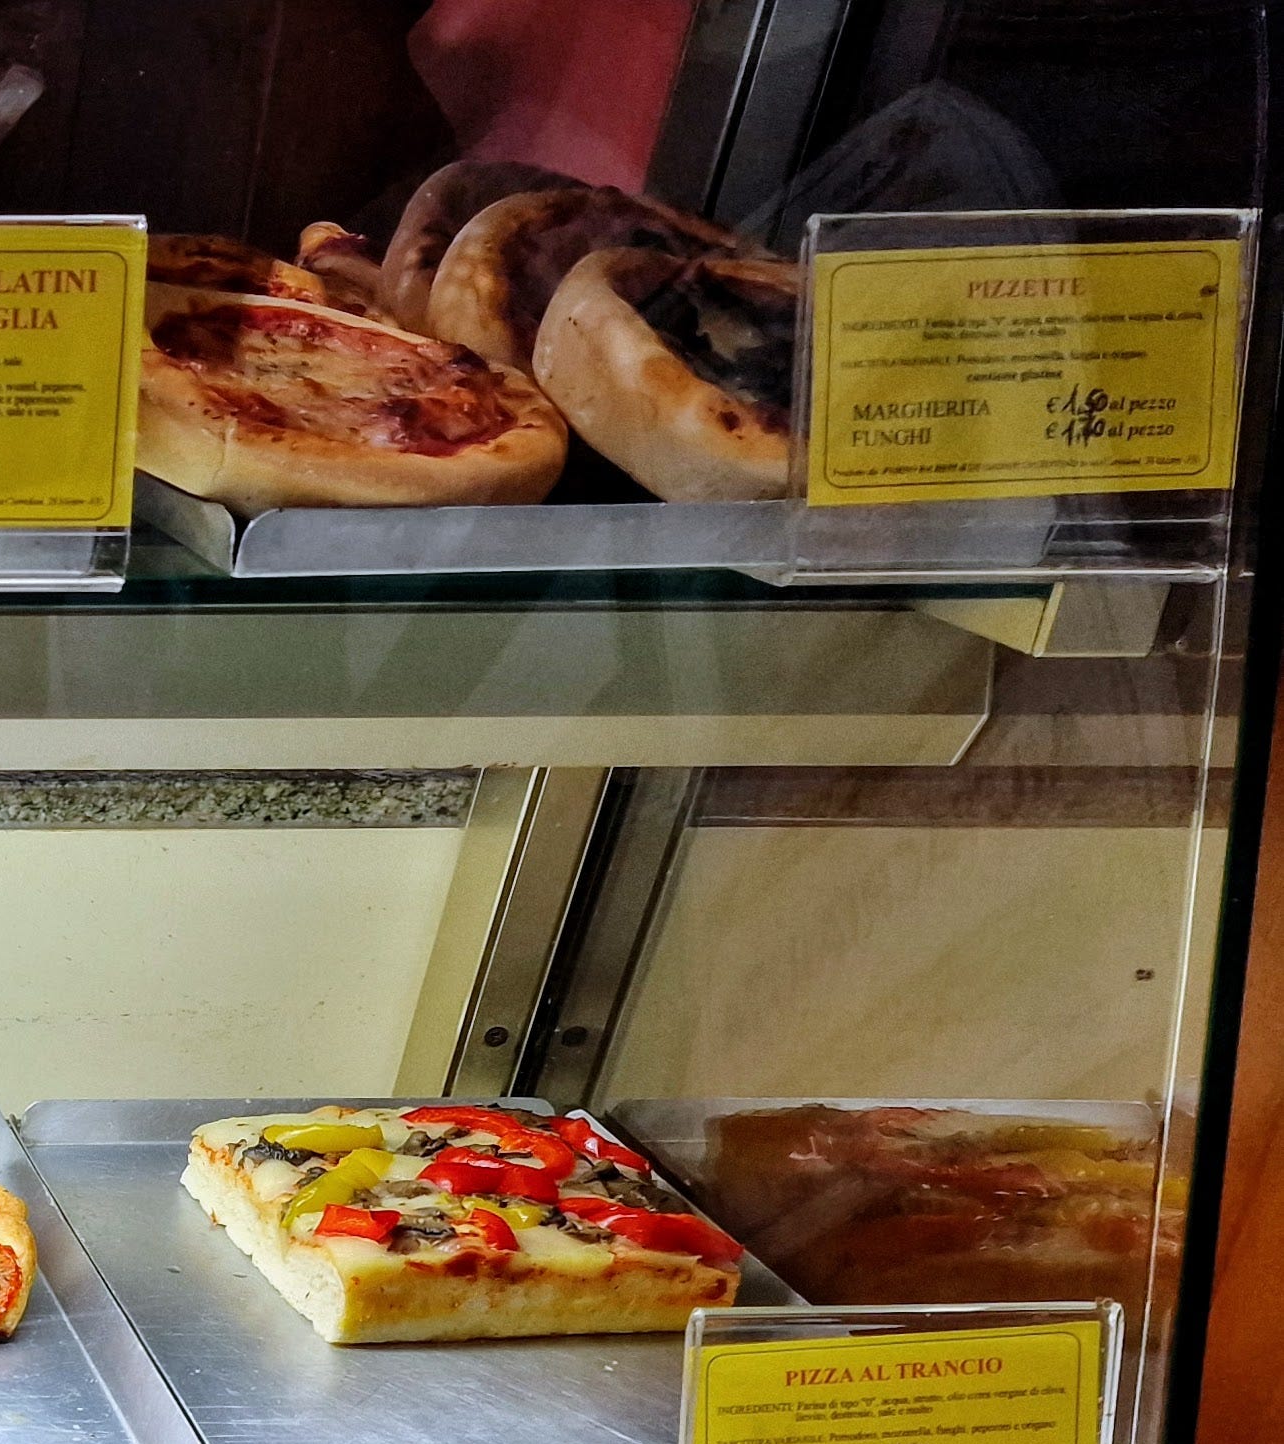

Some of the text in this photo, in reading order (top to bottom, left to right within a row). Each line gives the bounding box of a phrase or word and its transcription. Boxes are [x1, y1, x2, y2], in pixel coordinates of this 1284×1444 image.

[967, 277, 1087, 299] PIZZETTE
[852, 398, 991, 422] MARGHERITA
[1128, 399, 1177, 416] pezzo
[852, 427, 932, 448] FUNGHI
[1127, 424, 1175, 441] pezzo
[784, 1356, 1003, 1388] PIZZA AL TRANCIO
